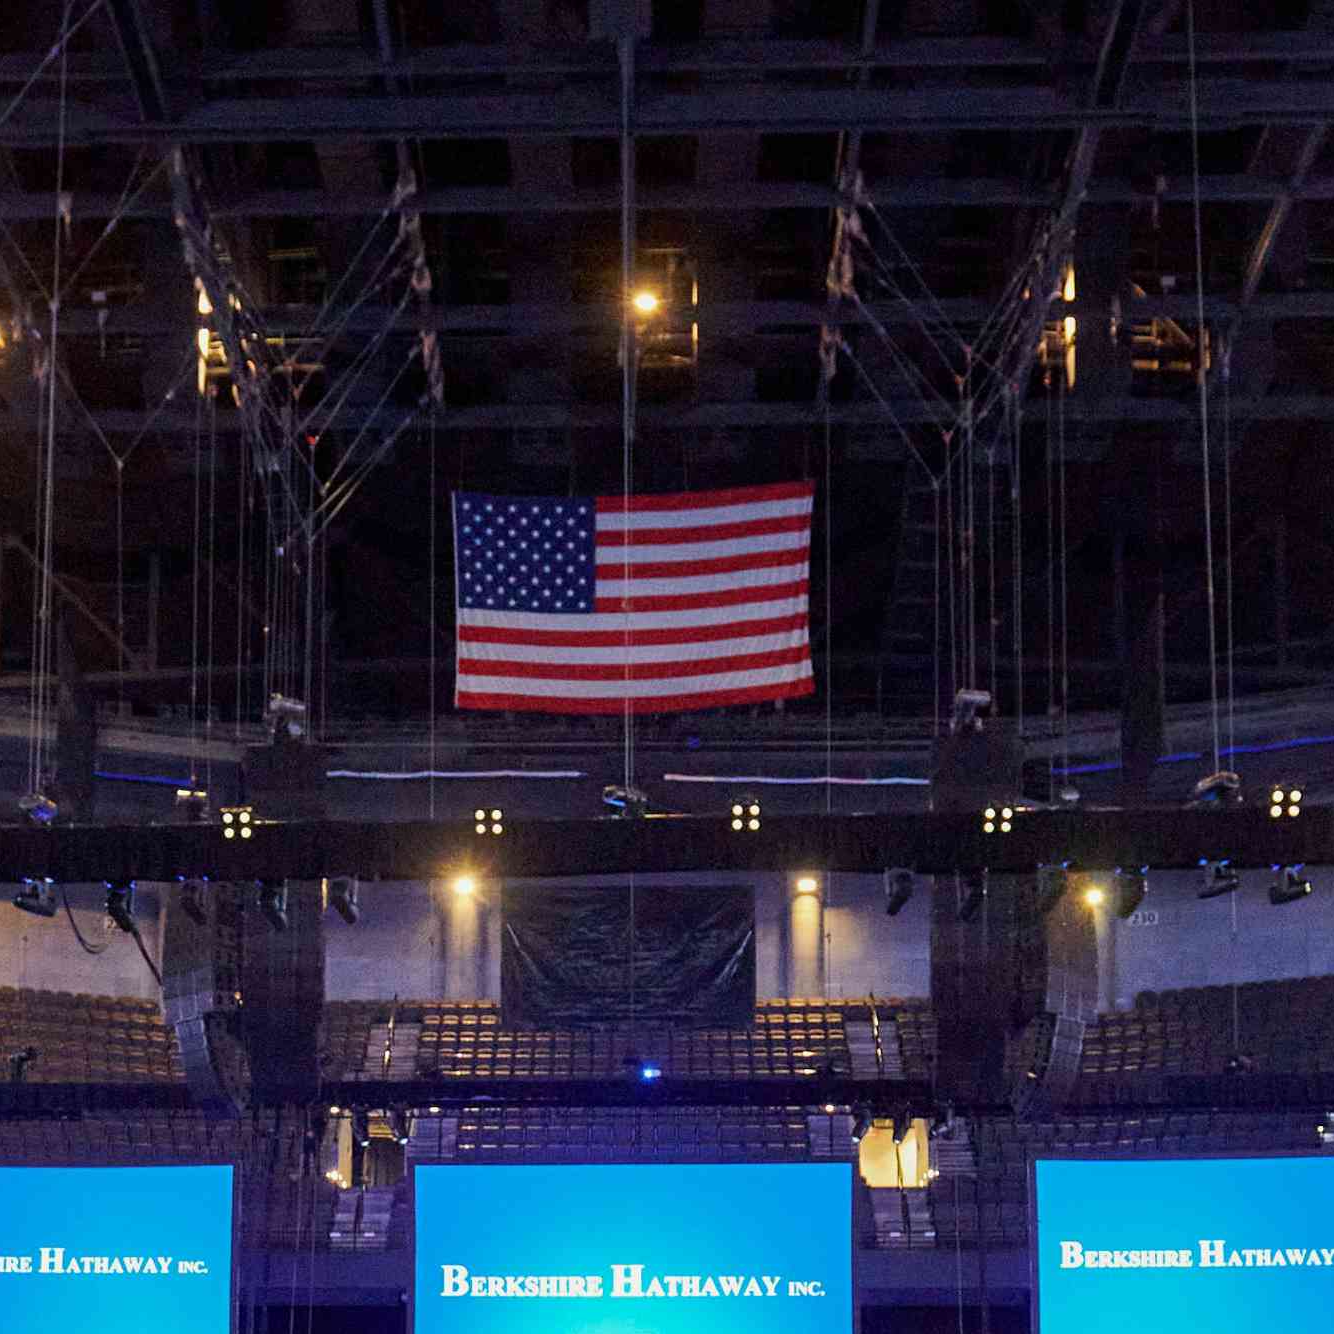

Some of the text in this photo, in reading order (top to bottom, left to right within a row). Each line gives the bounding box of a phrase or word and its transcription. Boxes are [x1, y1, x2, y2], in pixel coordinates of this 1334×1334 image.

[38, 1247, 172, 1274] HATHAWAY
[178, 1261, 208, 1274] INC.
[1060, 1240, 1193, 1268] BERKSHIRE
[440, 1263, 826, 1298] BERKSHIRE HATHAWAY INC.
